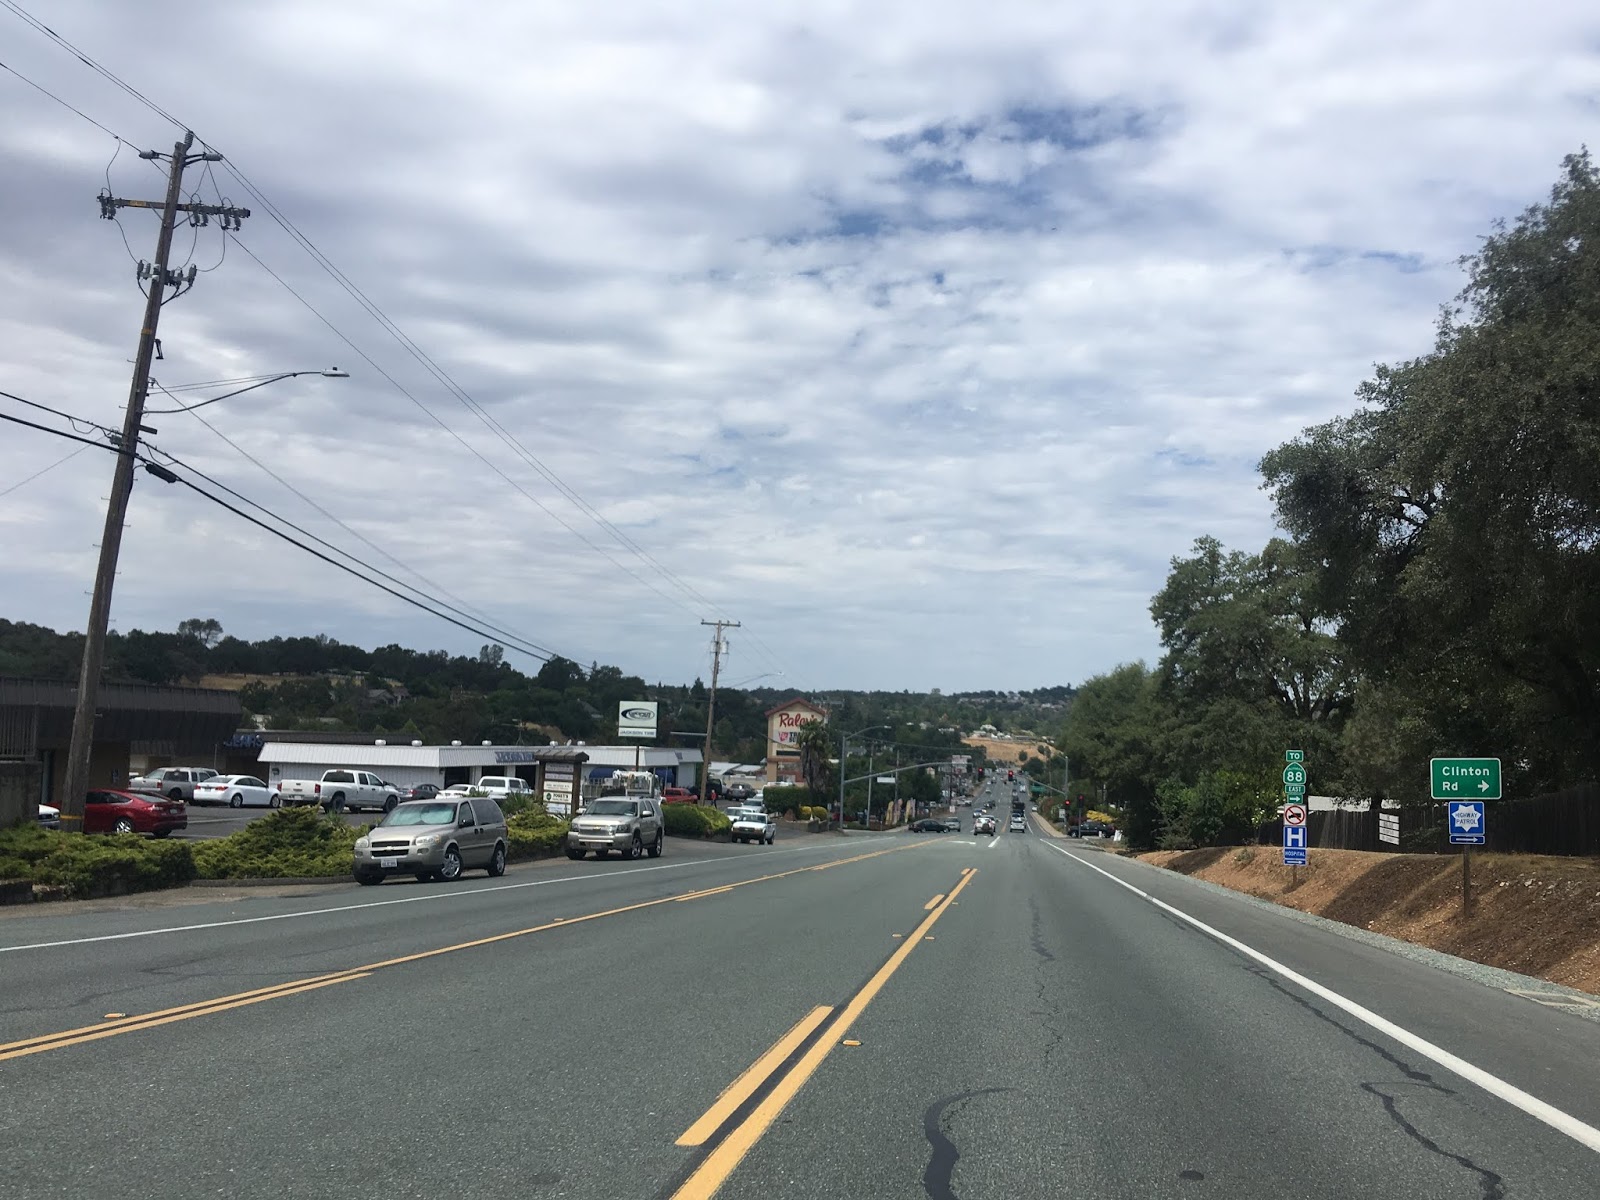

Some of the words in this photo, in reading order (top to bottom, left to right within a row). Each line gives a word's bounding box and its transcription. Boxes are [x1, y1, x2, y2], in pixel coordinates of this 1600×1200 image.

[1289, 752, 1301, 760] TO
[1442, 766, 1490, 776] Clinton
[1286, 771, 1303, 782] 88
[1442, 781, 1459, 791] Rd
[1286, 827, 1304, 847] H
